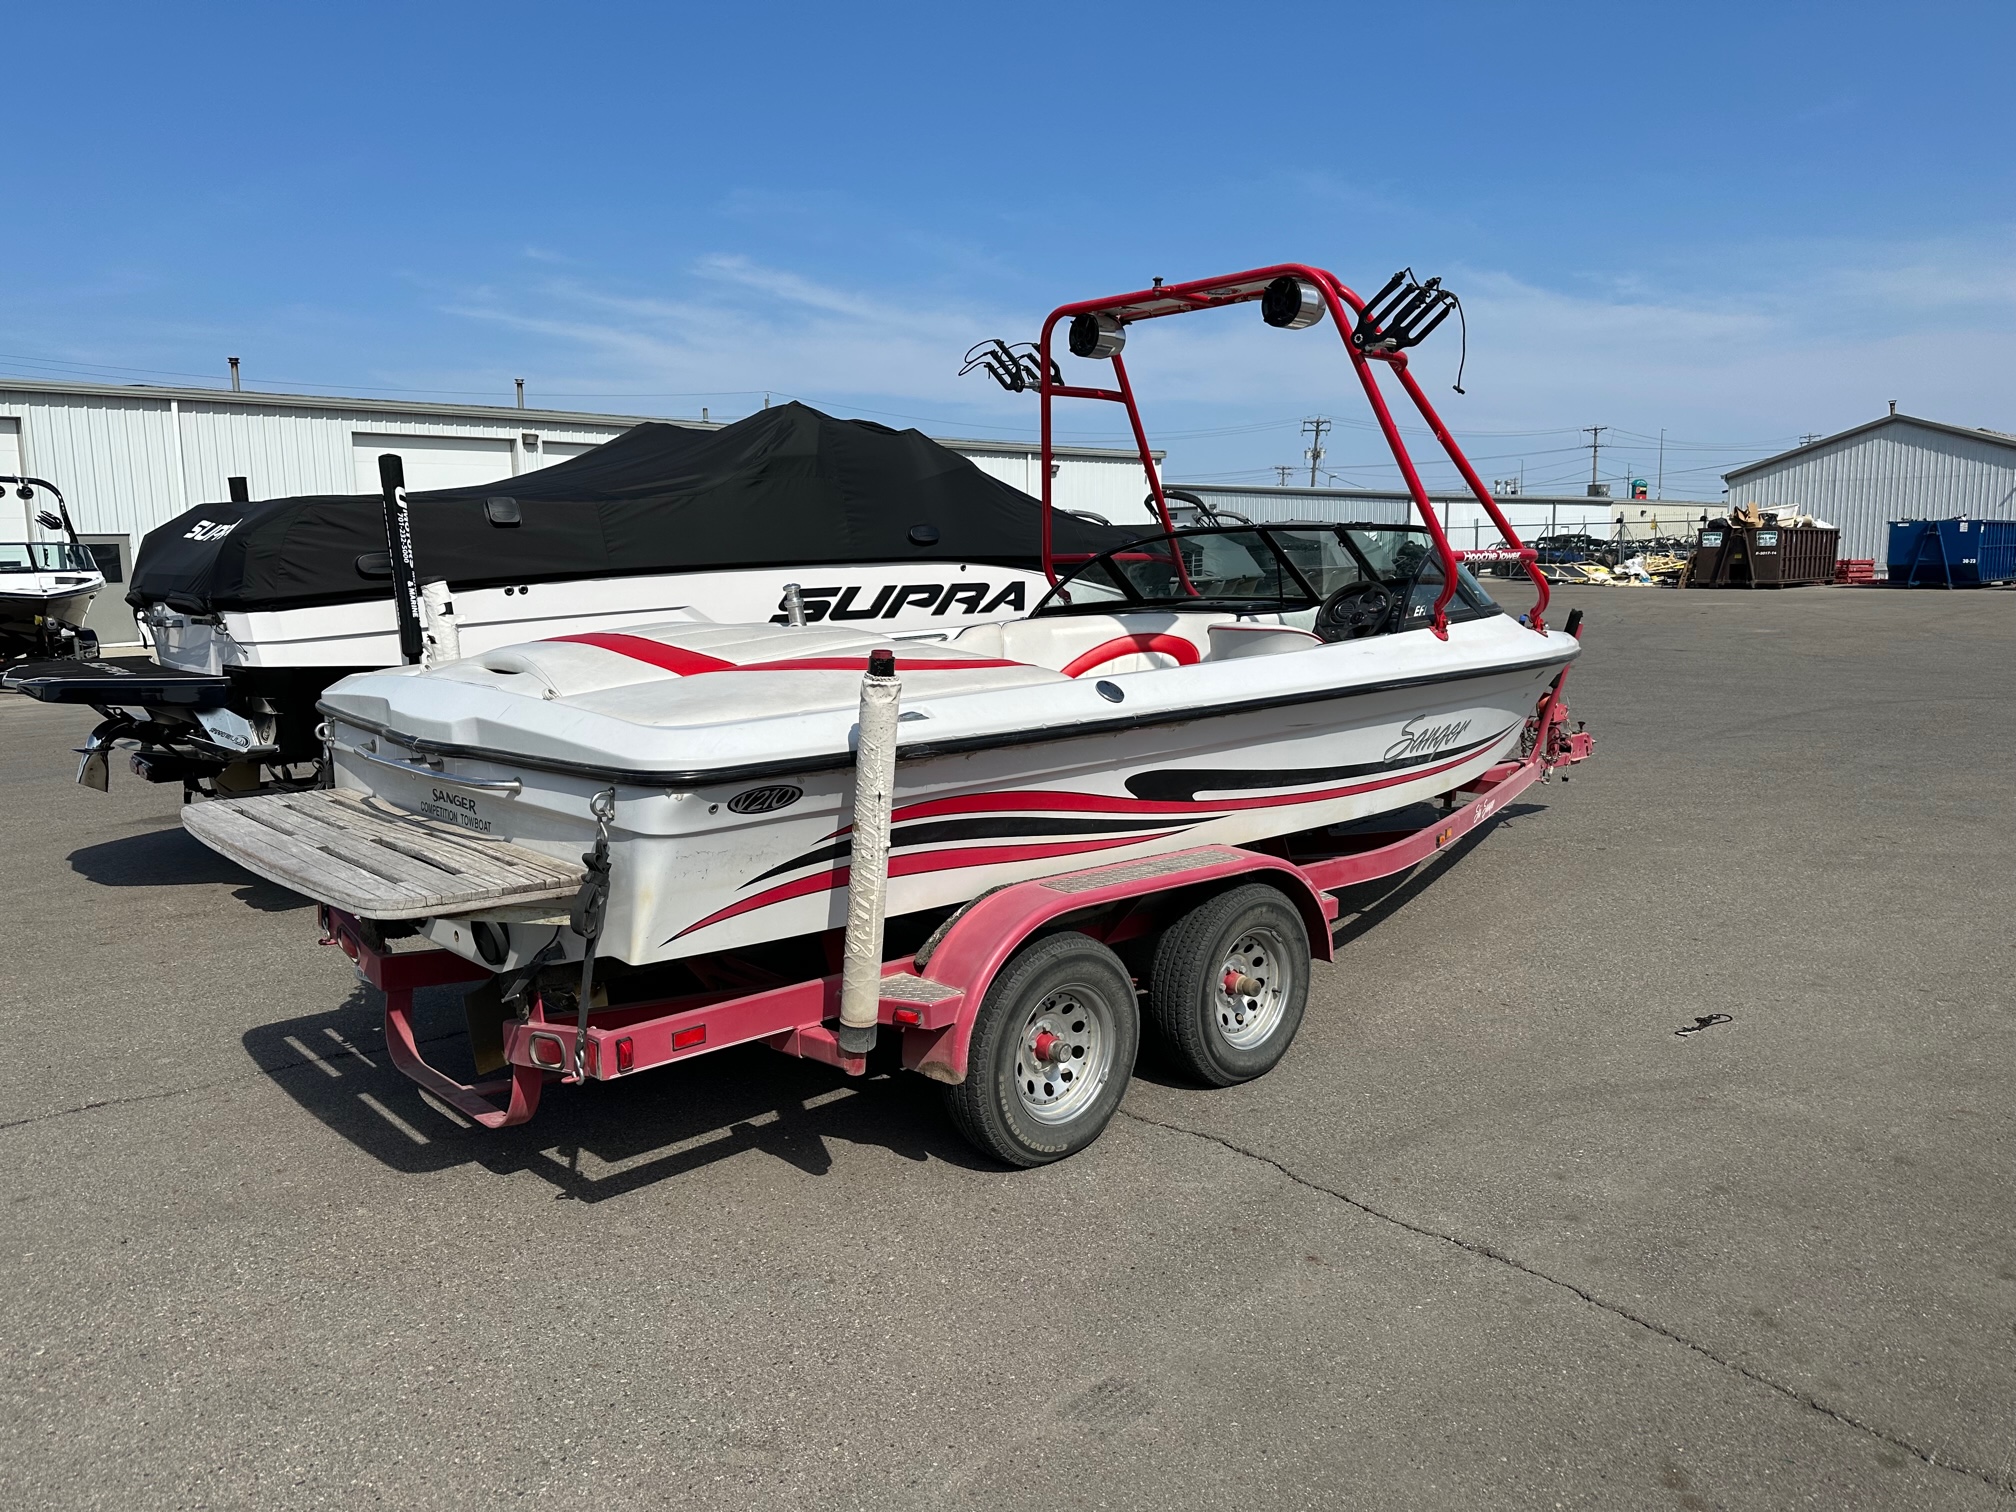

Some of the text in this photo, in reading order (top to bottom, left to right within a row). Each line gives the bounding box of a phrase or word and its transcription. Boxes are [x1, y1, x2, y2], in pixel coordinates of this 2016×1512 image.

[1463, 550, 1521, 561] Hoochie Tower
[409, 588, 419, 618] MARINE
[768, 581, 1026, 626] SUPRA
[1383, 713, 1472, 764] Sanger
[432, 788, 477, 815] SANGER
[735, 786, 795, 813] V210
[420, 801, 492, 833] COMPETITION TOWBOAT
